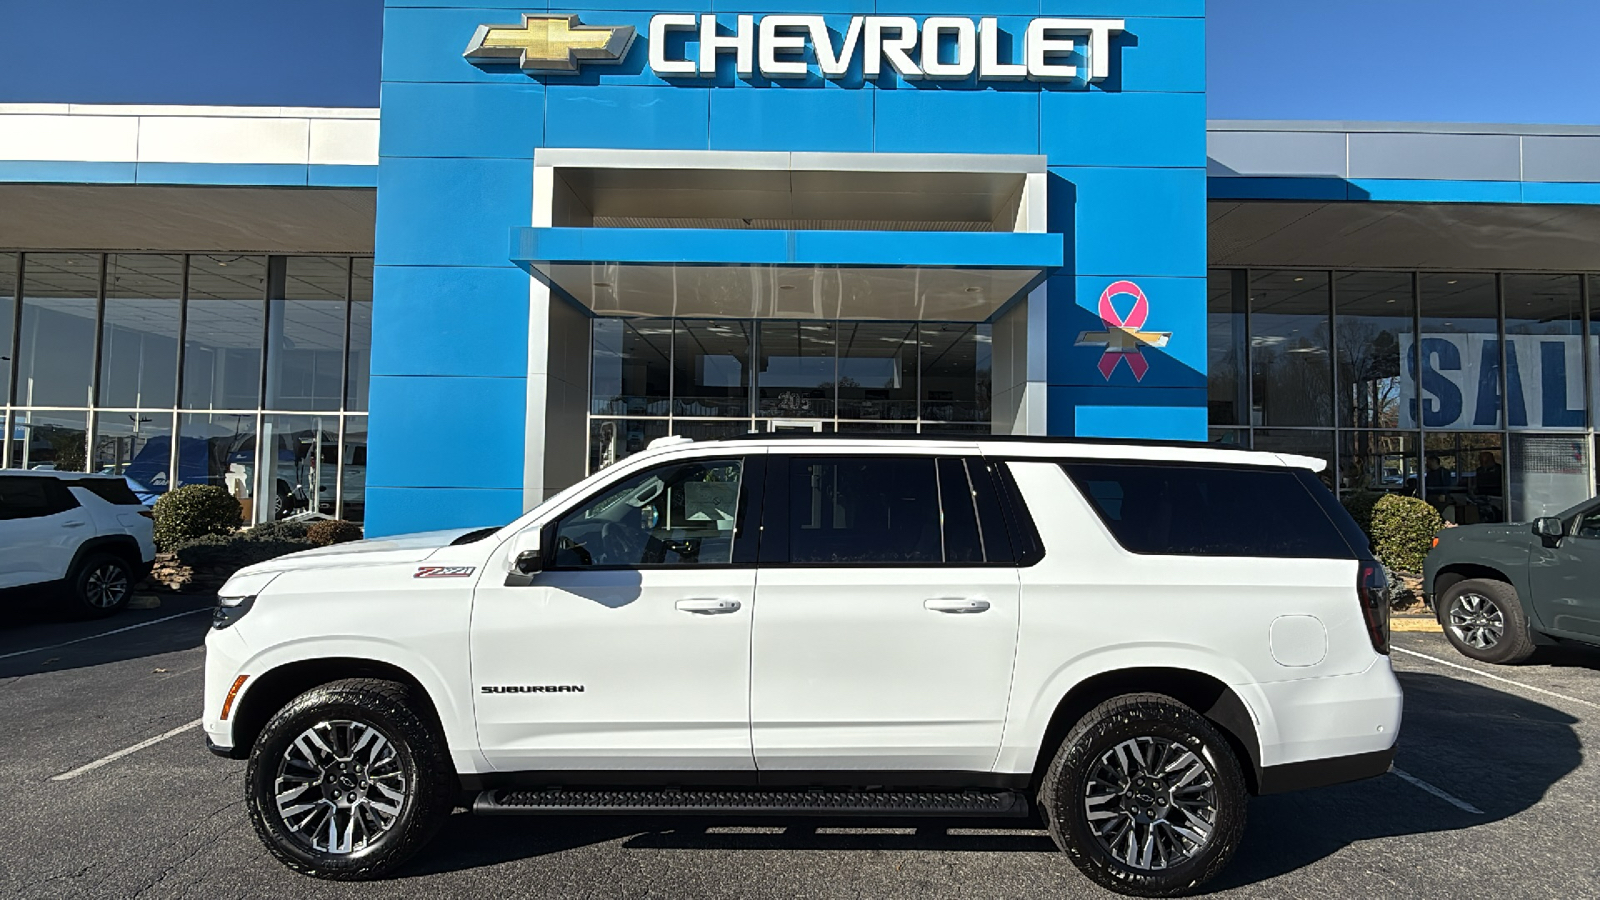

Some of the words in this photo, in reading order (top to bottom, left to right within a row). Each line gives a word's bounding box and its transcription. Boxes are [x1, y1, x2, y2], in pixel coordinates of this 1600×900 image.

[648, 13, 1125, 82] CHEVROLET
[413, 566, 476, 578] Z71
[481, 685, 585, 694] SUBURBAN
